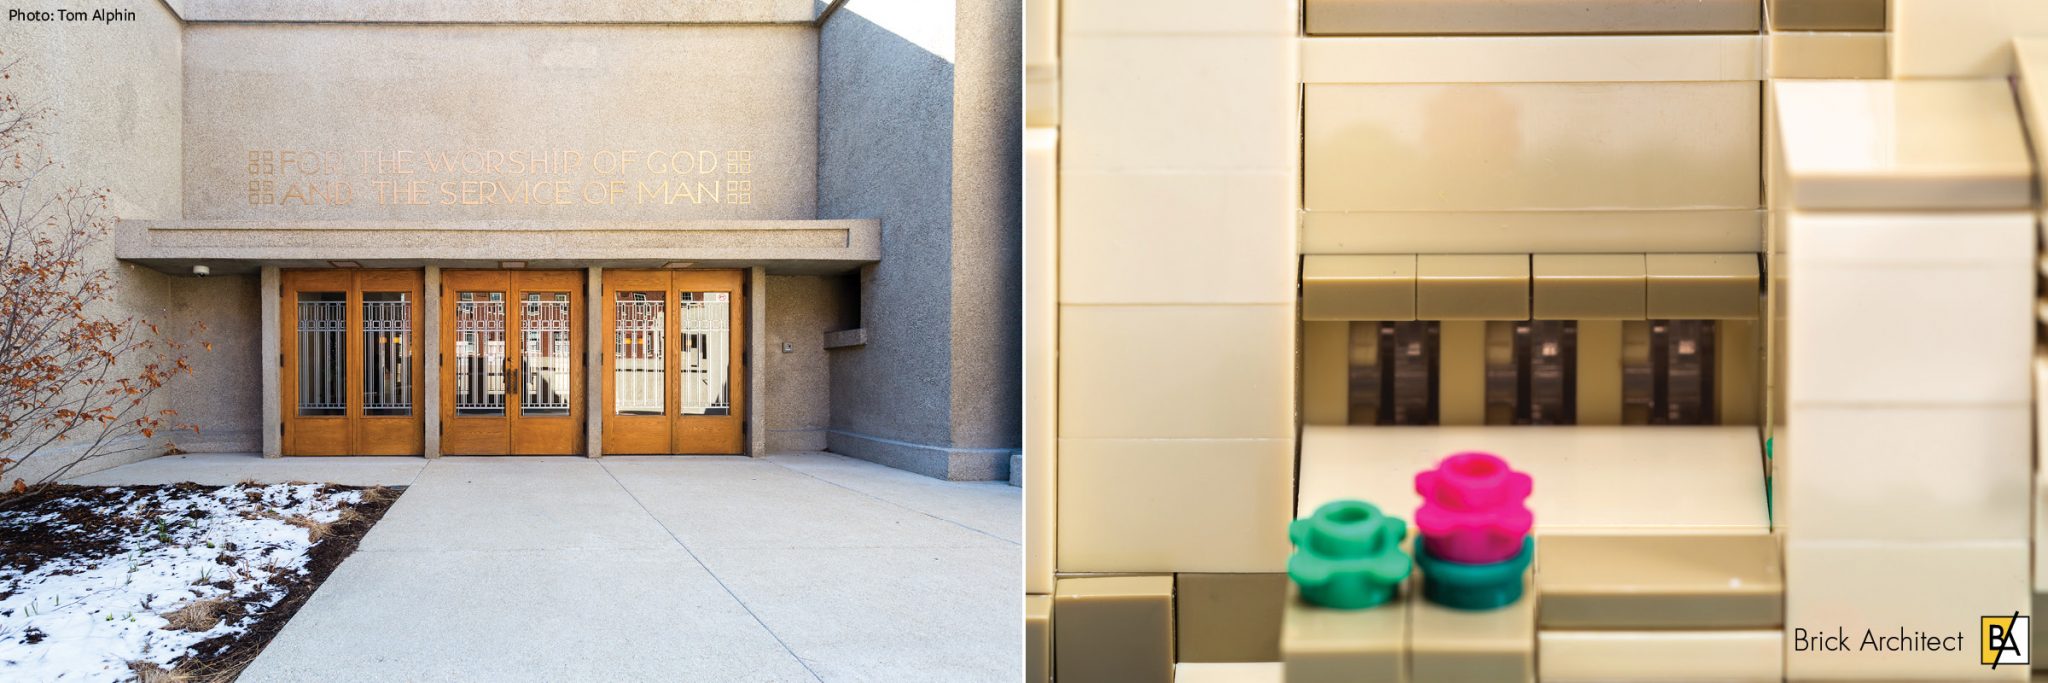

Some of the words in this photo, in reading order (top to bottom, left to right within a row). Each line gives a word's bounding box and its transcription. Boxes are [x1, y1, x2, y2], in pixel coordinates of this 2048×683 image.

[279, 150, 341, 175] FOR
[360, 150, 414, 174] THE
[424, 150, 583, 175] WORSHIP
[593, 150, 638, 175] OF
[646, 150, 718, 175] GOD
[279, 180, 353, 206] AND
[371, 180, 431, 206] THE
[440, 180, 575, 205] SERVICE
[583, 180, 625, 205] OF
[638, 180, 720, 205] MAN
